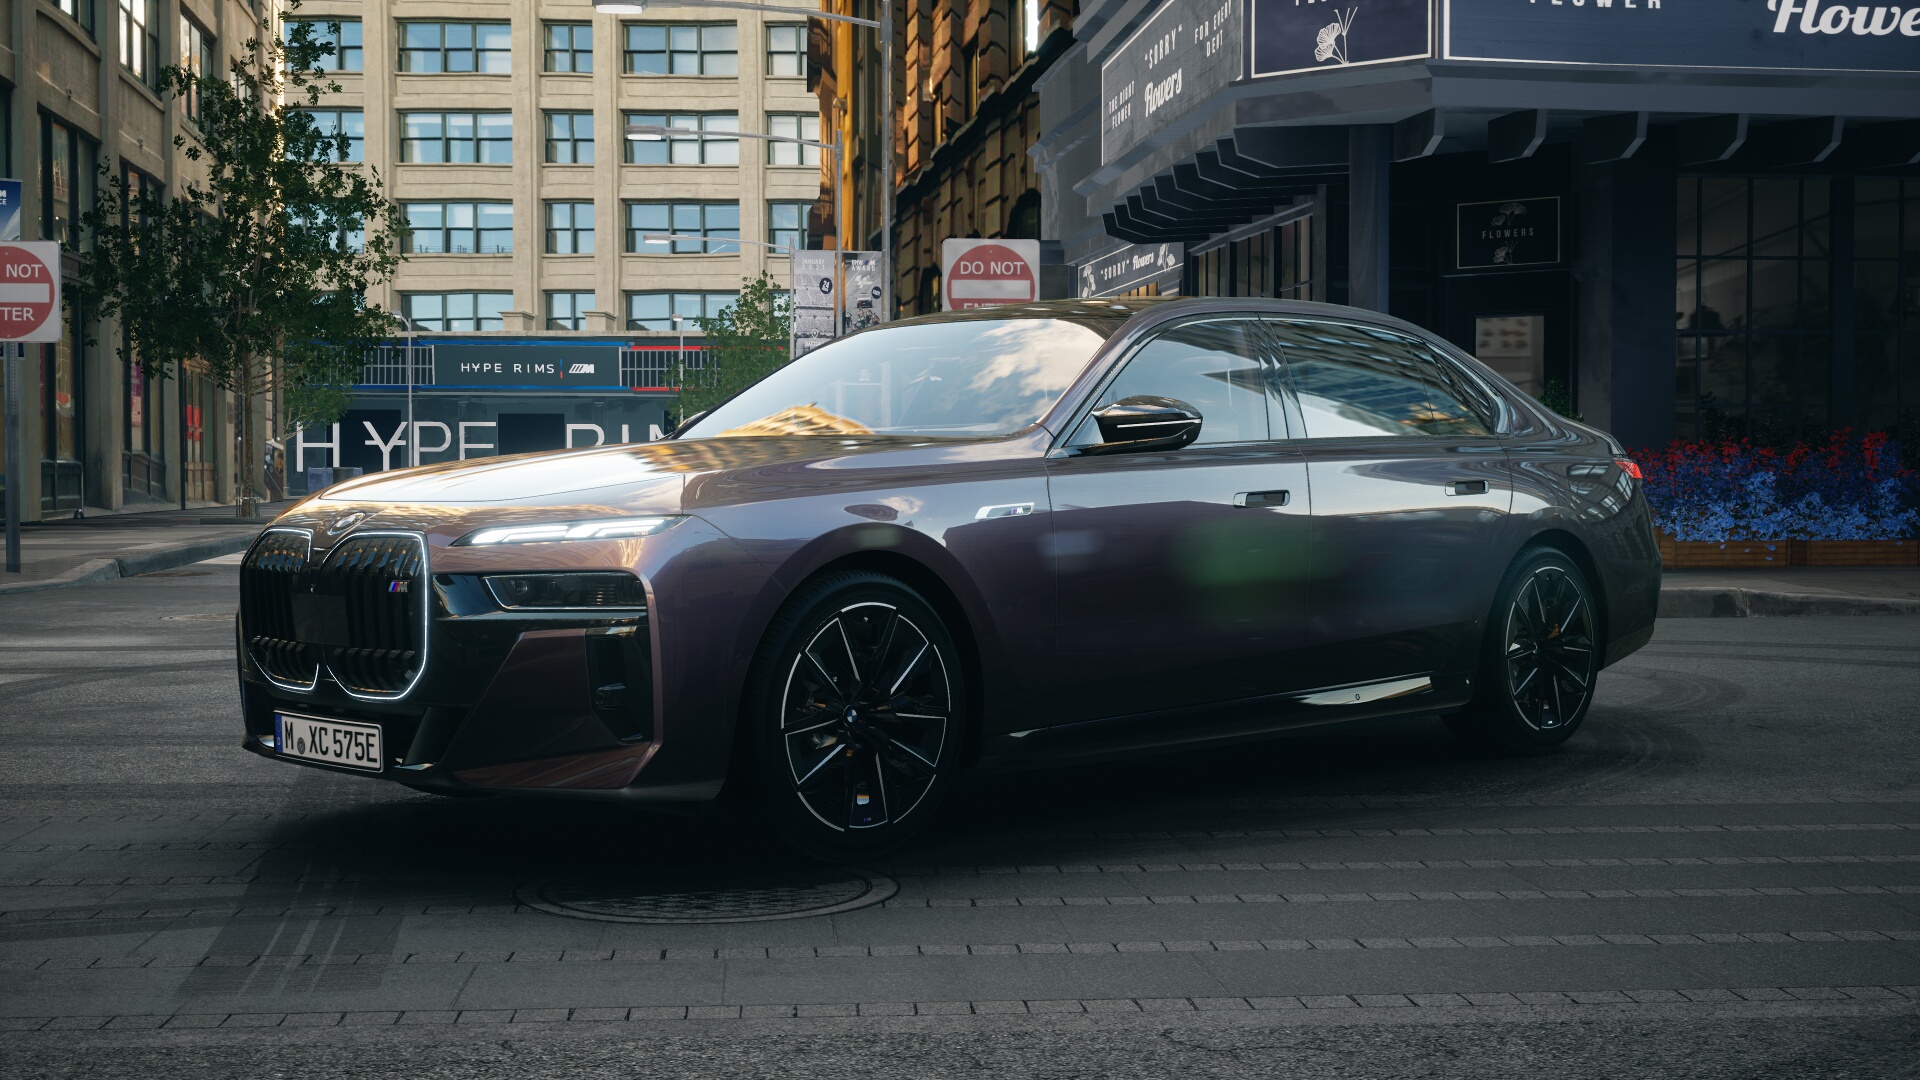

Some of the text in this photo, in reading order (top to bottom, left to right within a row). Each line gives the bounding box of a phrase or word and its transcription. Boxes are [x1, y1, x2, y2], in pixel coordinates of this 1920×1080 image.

[1194, 0, 1232, 45] FOR EVERY
[1206, 29, 1224, 58] DENT
[1482, 227, 1534, 240] FLOWERS
[6, 263, 43, 279] NOT
[960, 261, 1025, 275] DO NOT
[460, 362, 503, 374] HYPE
[513, 363, 555, 374] RIMS
[284, 720, 295, 750] M
[332, 728, 379, 764] 575E
